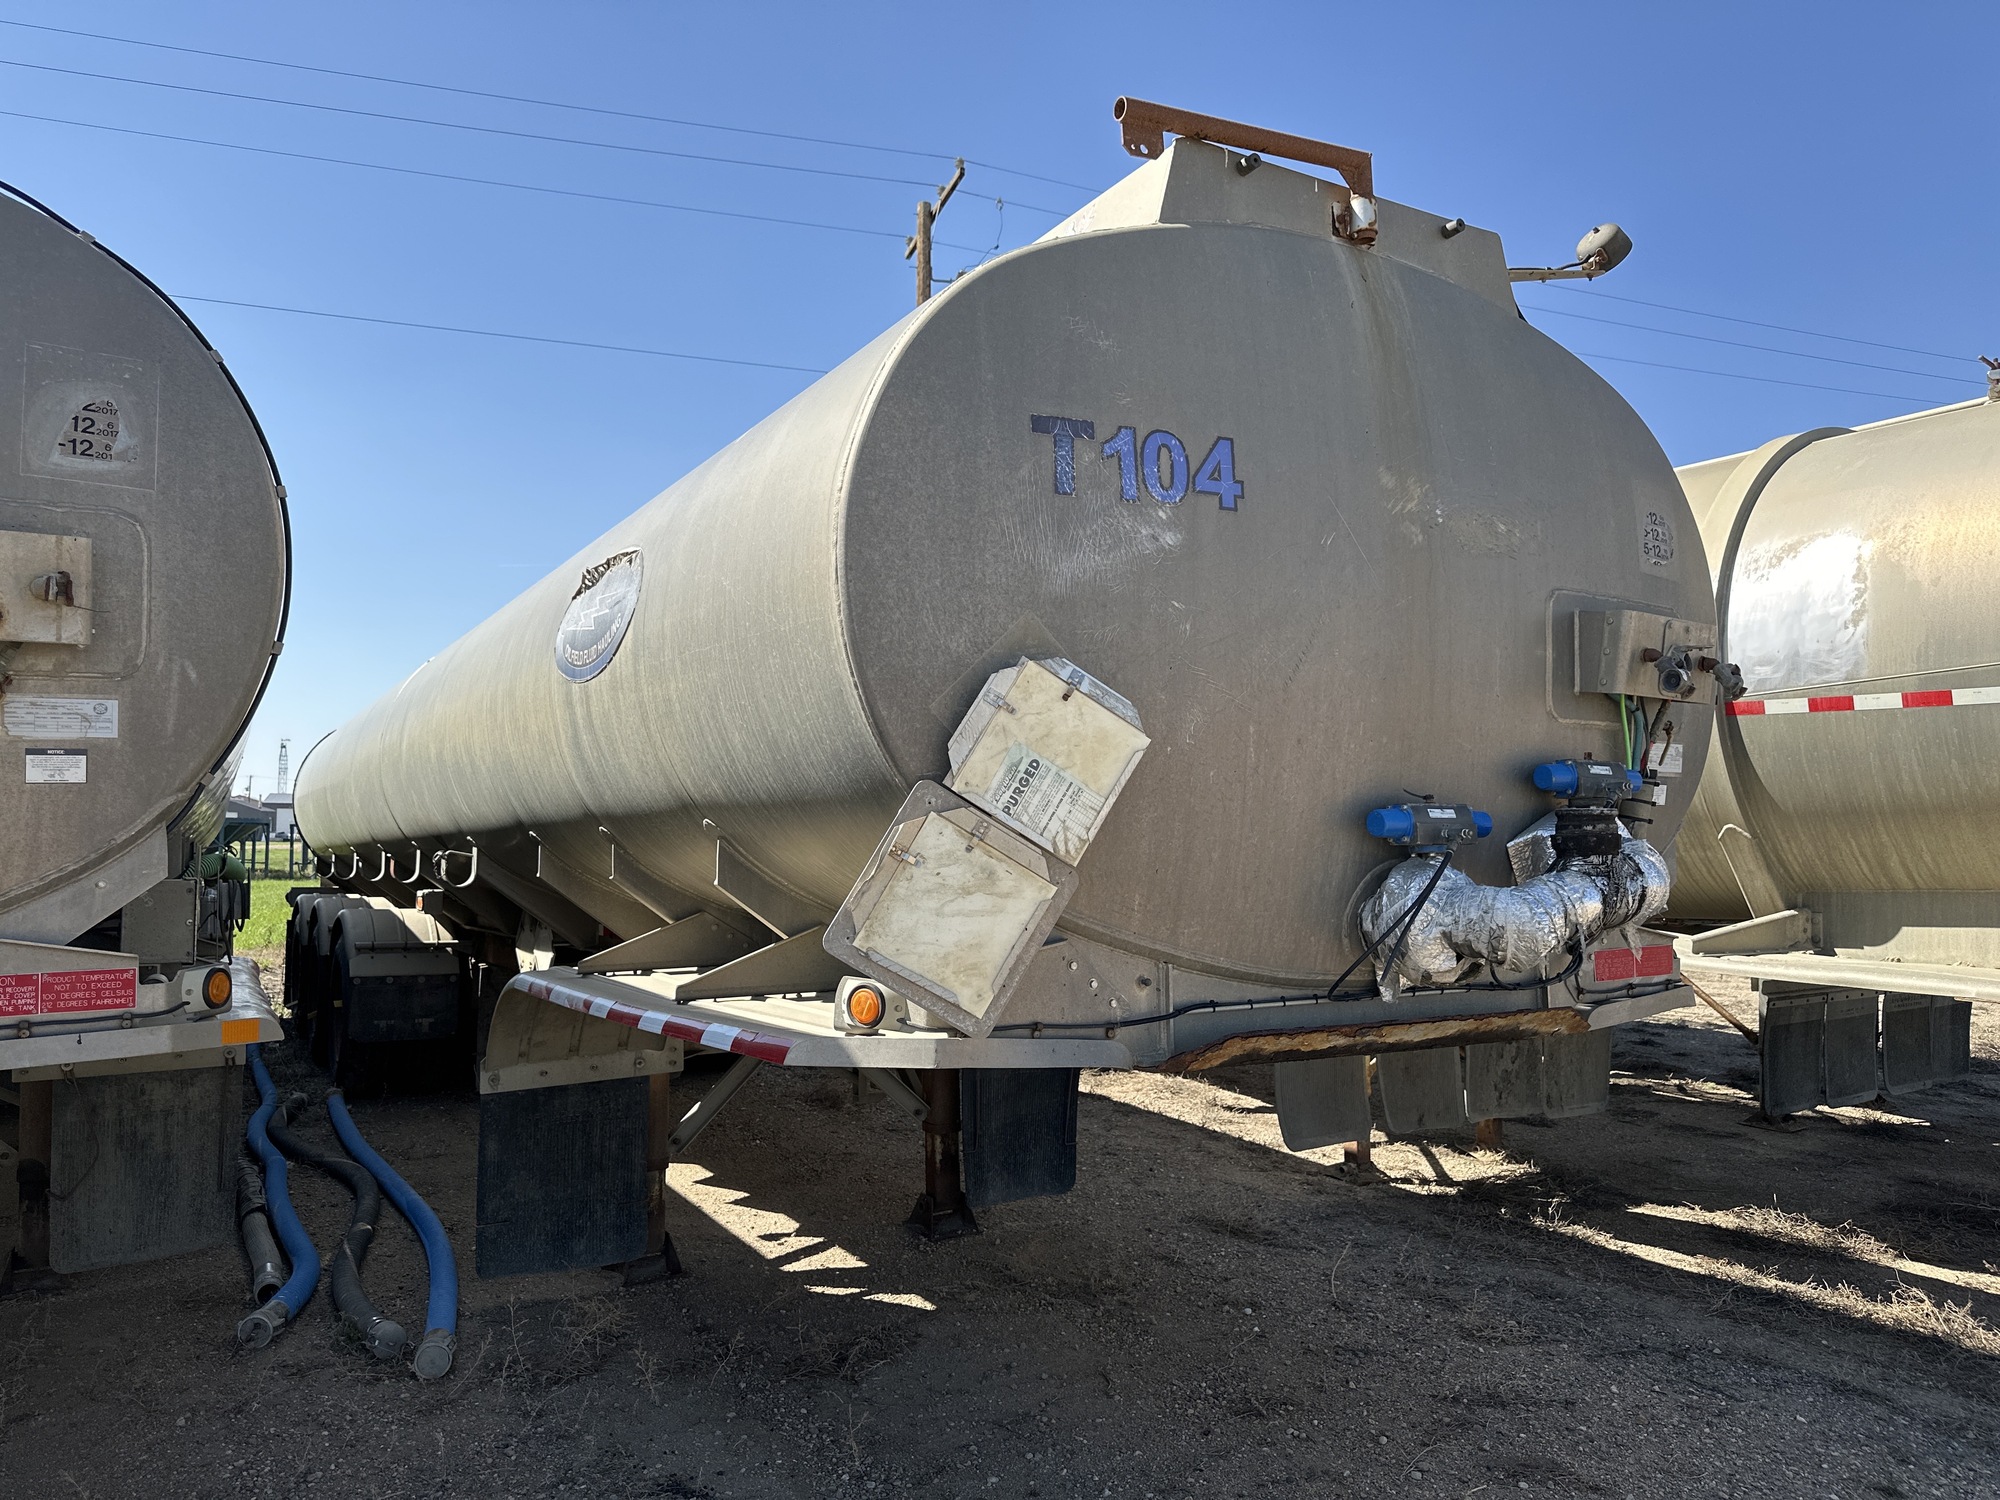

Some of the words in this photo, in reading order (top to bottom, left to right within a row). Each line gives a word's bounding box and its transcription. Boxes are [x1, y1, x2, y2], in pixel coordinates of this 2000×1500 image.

[96, 406, 119, 416] 2017
[71, 415, 96, 435] 12
[107, 422, 114, 430] 6
[96, 428, 119, 438] 2017
[584, 645, 597, 664] FLUID
[597, 612, 621, 656] HAULING
[1002, 758, 1040, 817] PURGED
[42, 975, 76, 984] PRODUCT
[81, 973, 134, 982] TEMPERATURE
[6, 985, 36, 993] RECOVERY
[91, 981, 122, 989] EXCEED
[60, 991, 97, 999] DEGREES
[101, 989, 134, 997] CELSIUS
[11, 998, 36, 1006] PUMPING
[42, 1001, 53, 1009] 212
[57, 1000, 88, 1008] DEGREES
[91, 997, 133, 1006] FAHRENHEIT
